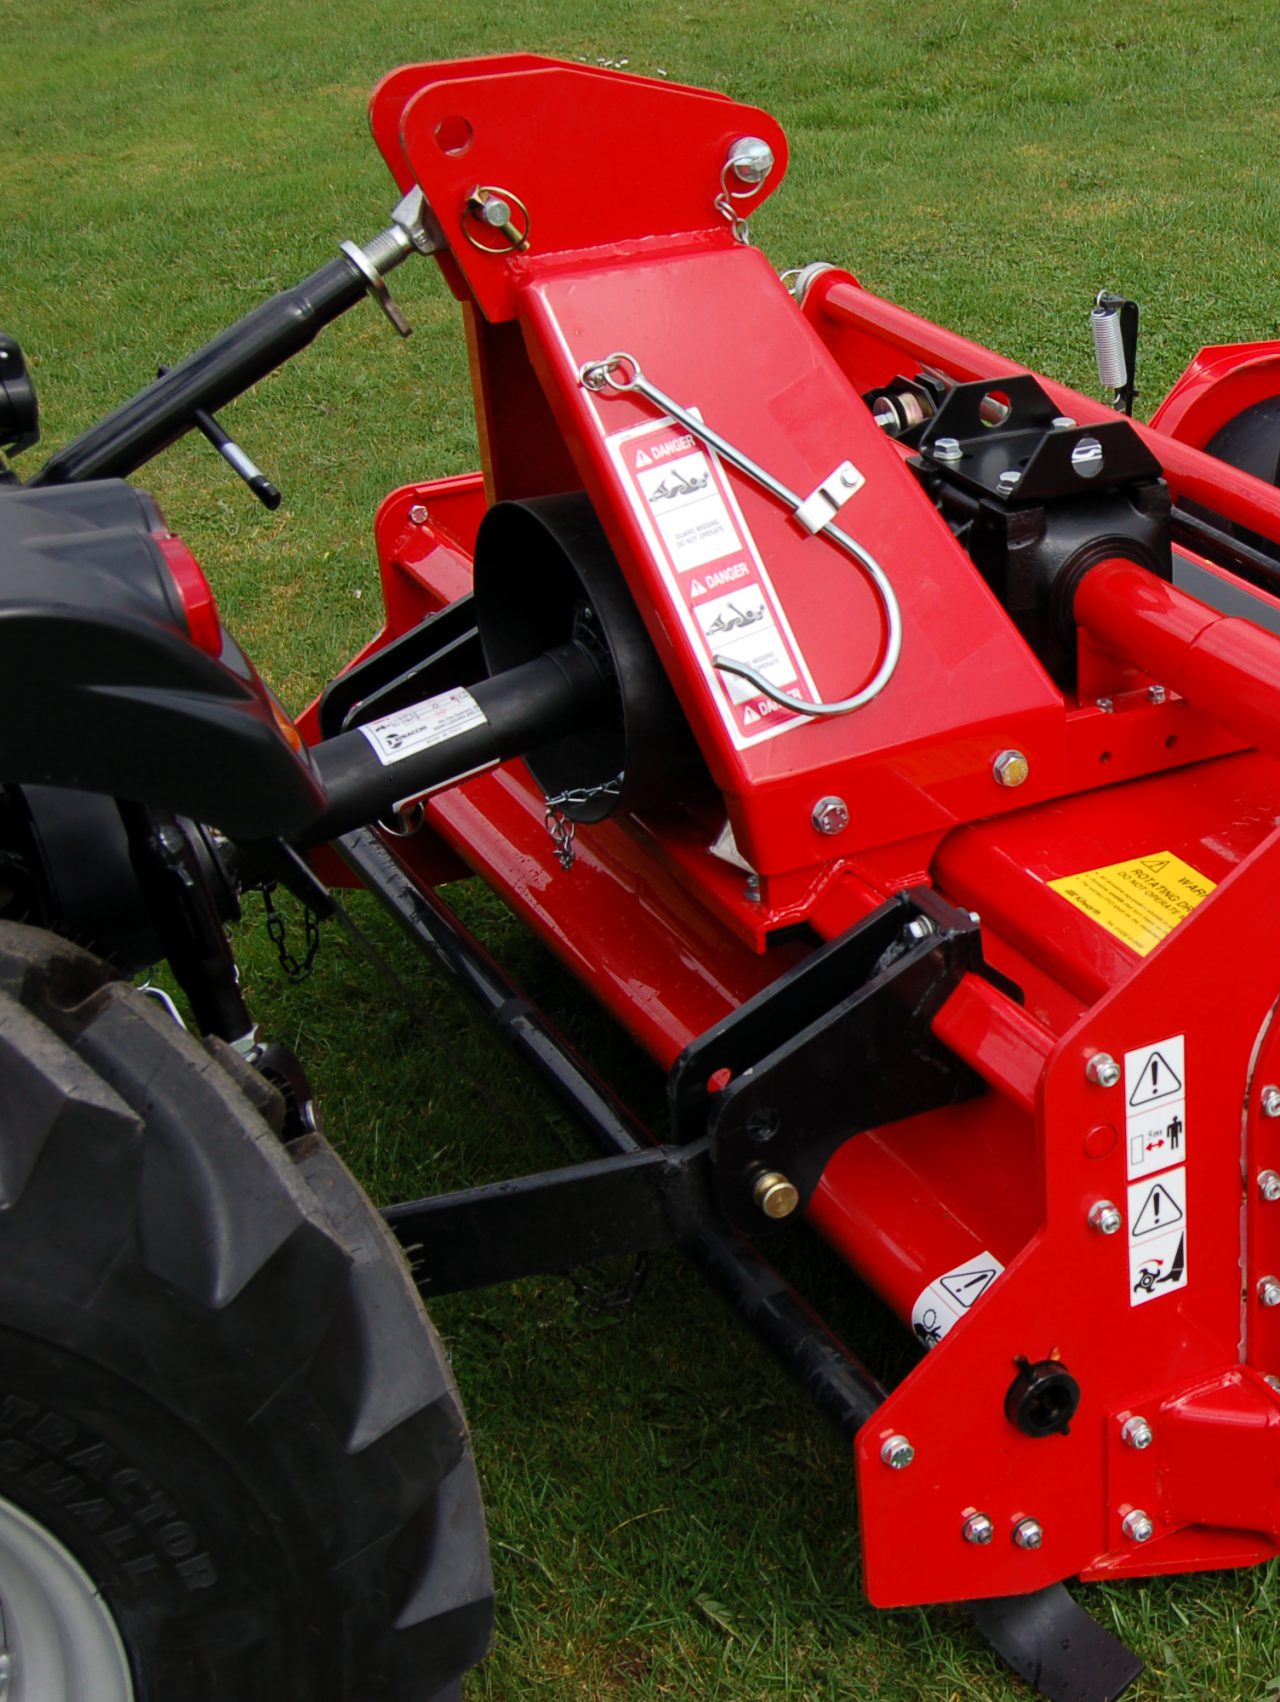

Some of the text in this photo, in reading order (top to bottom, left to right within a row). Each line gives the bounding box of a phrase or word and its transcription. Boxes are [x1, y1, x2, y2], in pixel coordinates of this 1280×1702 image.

[651, 434, 696, 460] DANGER
[675, 527, 695, 540] GUARD
[704, 562, 750, 589] DANGER
[1117, 871, 1131, 880] DO
[1130, 879, 1148, 893] NOT
[1145, 890, 1181, 916] OPERATE
[1131, 868, 1181, 902] ROTATING
[0, 1393, 218, 1593] TRACTOR
